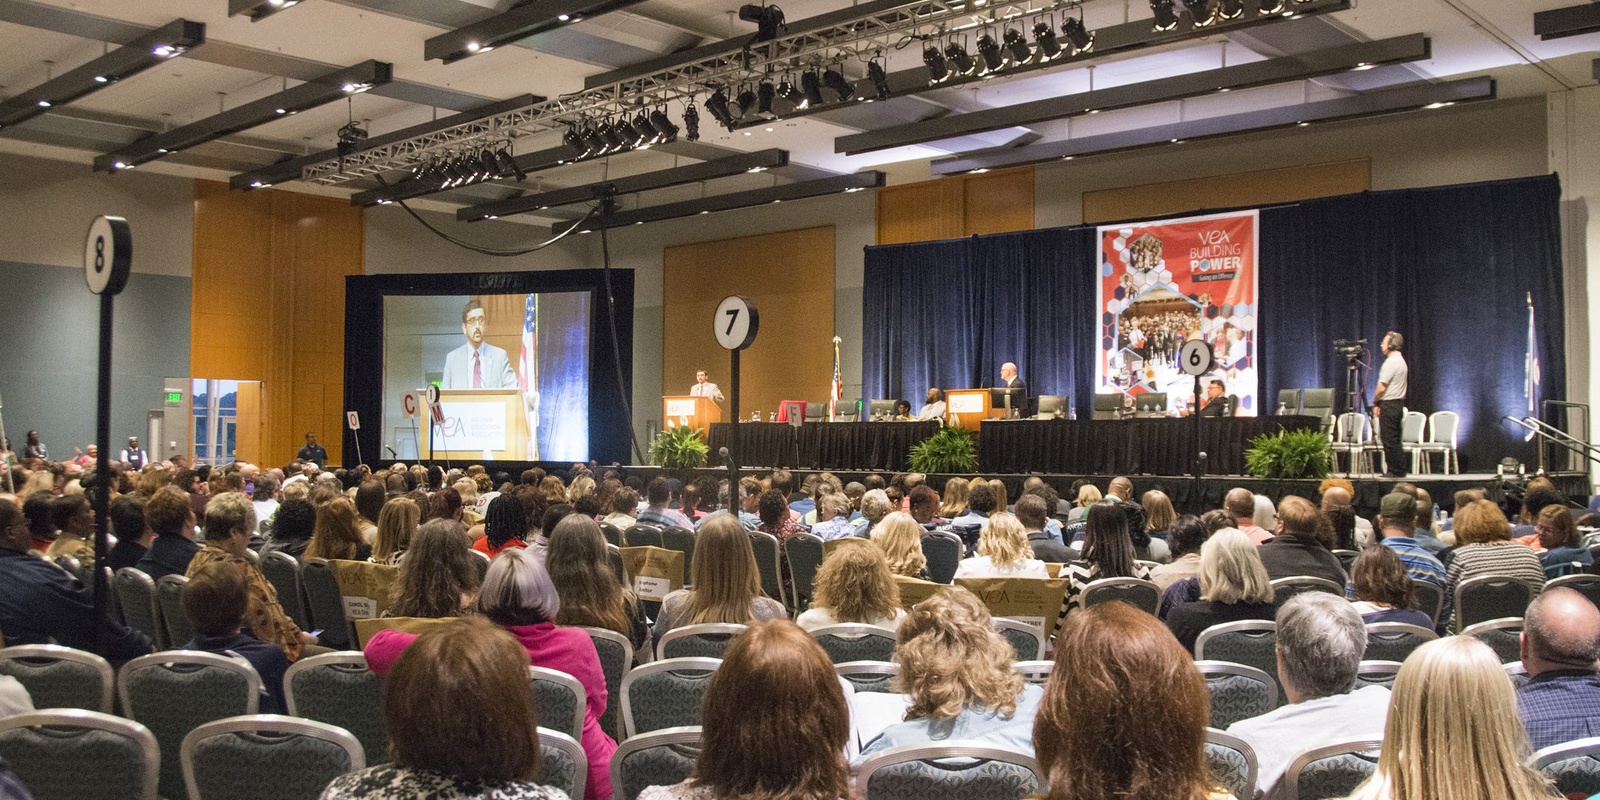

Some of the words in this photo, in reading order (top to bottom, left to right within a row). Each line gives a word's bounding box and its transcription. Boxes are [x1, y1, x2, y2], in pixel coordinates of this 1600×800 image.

[95, 235, 104, 273] 8
[1190, 243, 1240, 259] BUILDING
[1190, 256, 1240, 272] POWER
[726, 309, 740, 336] 7
[1190, 348, 1201, 367] 6
[404, 394, 415, 414] C
[431, 404, 444, 423] M
[790, 406, 797, 423] F
